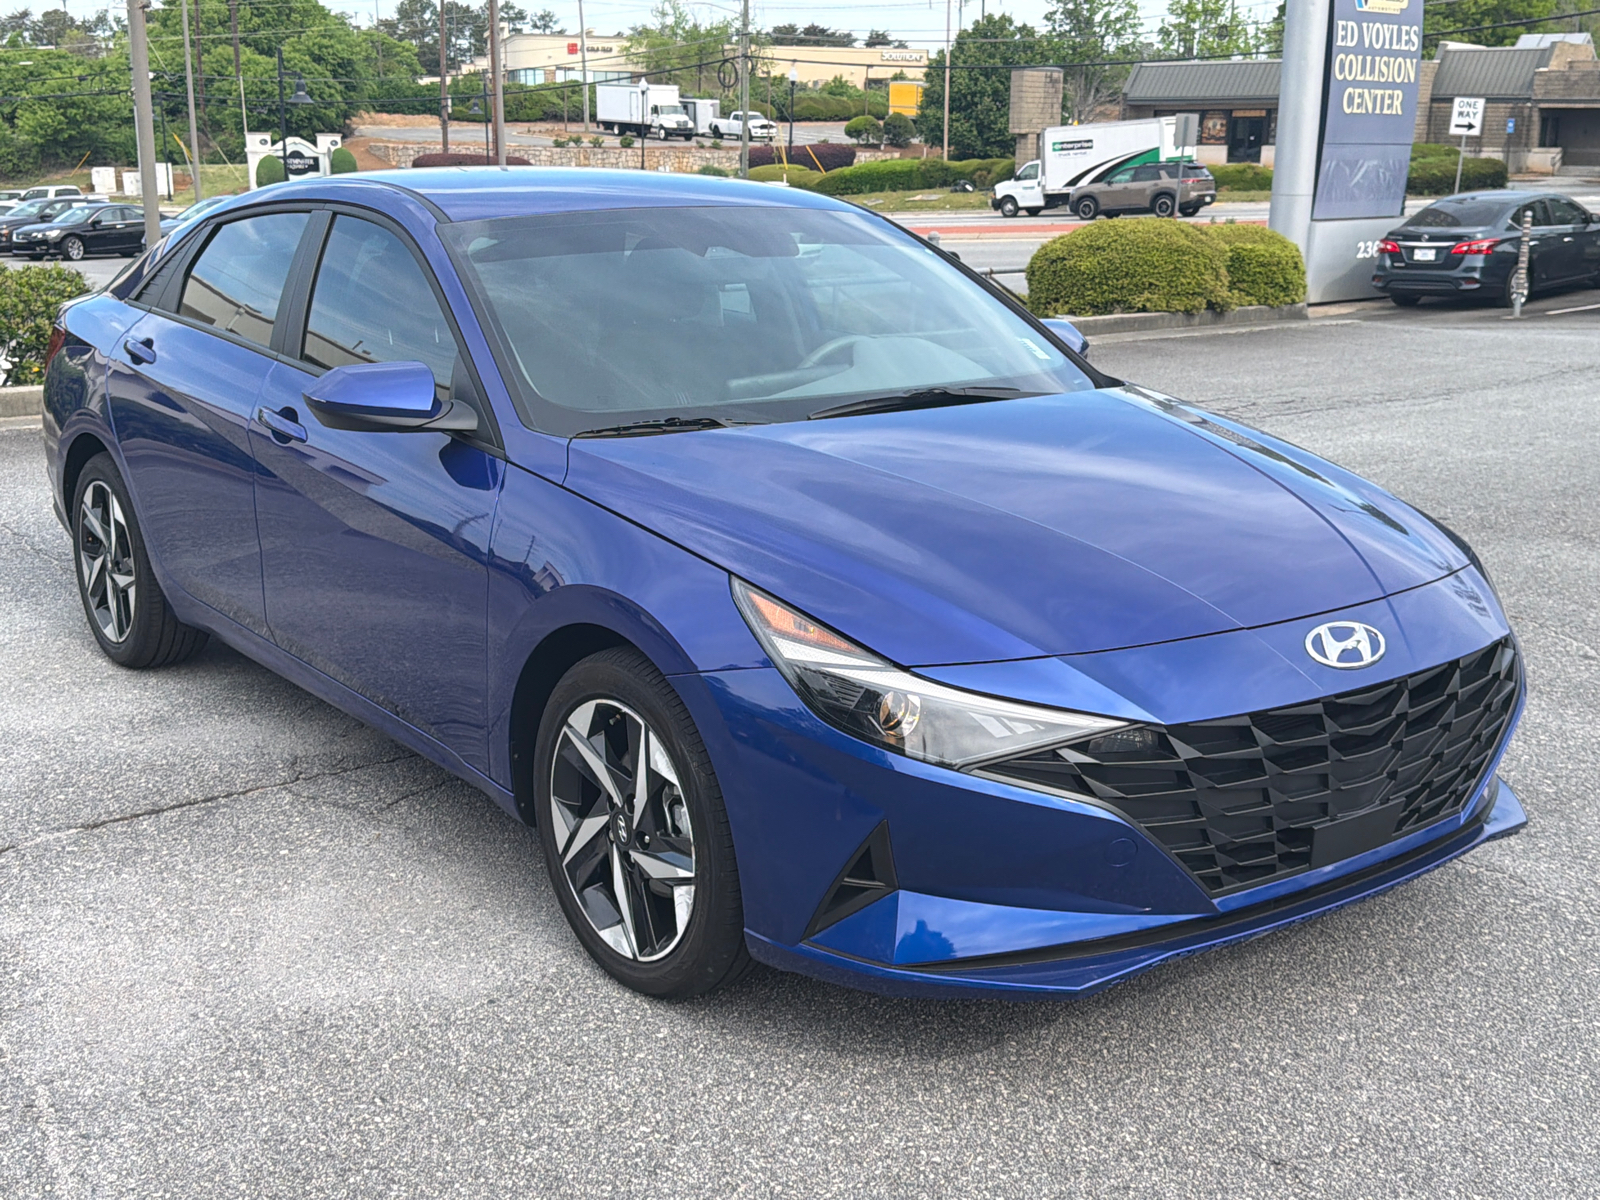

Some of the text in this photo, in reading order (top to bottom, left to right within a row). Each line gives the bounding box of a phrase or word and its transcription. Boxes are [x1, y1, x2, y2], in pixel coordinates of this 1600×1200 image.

[1336, 20, 1419, 52] ED VOYLES
[1335, 53, 1417, 83] COLLISION
[1342, 87, 1403, 115] CENTER
[1458, 100, 1479, 110] ONE
[1457, 110, 1479, 119] WAY
[1053, 141, 1093, 150] enterprise
